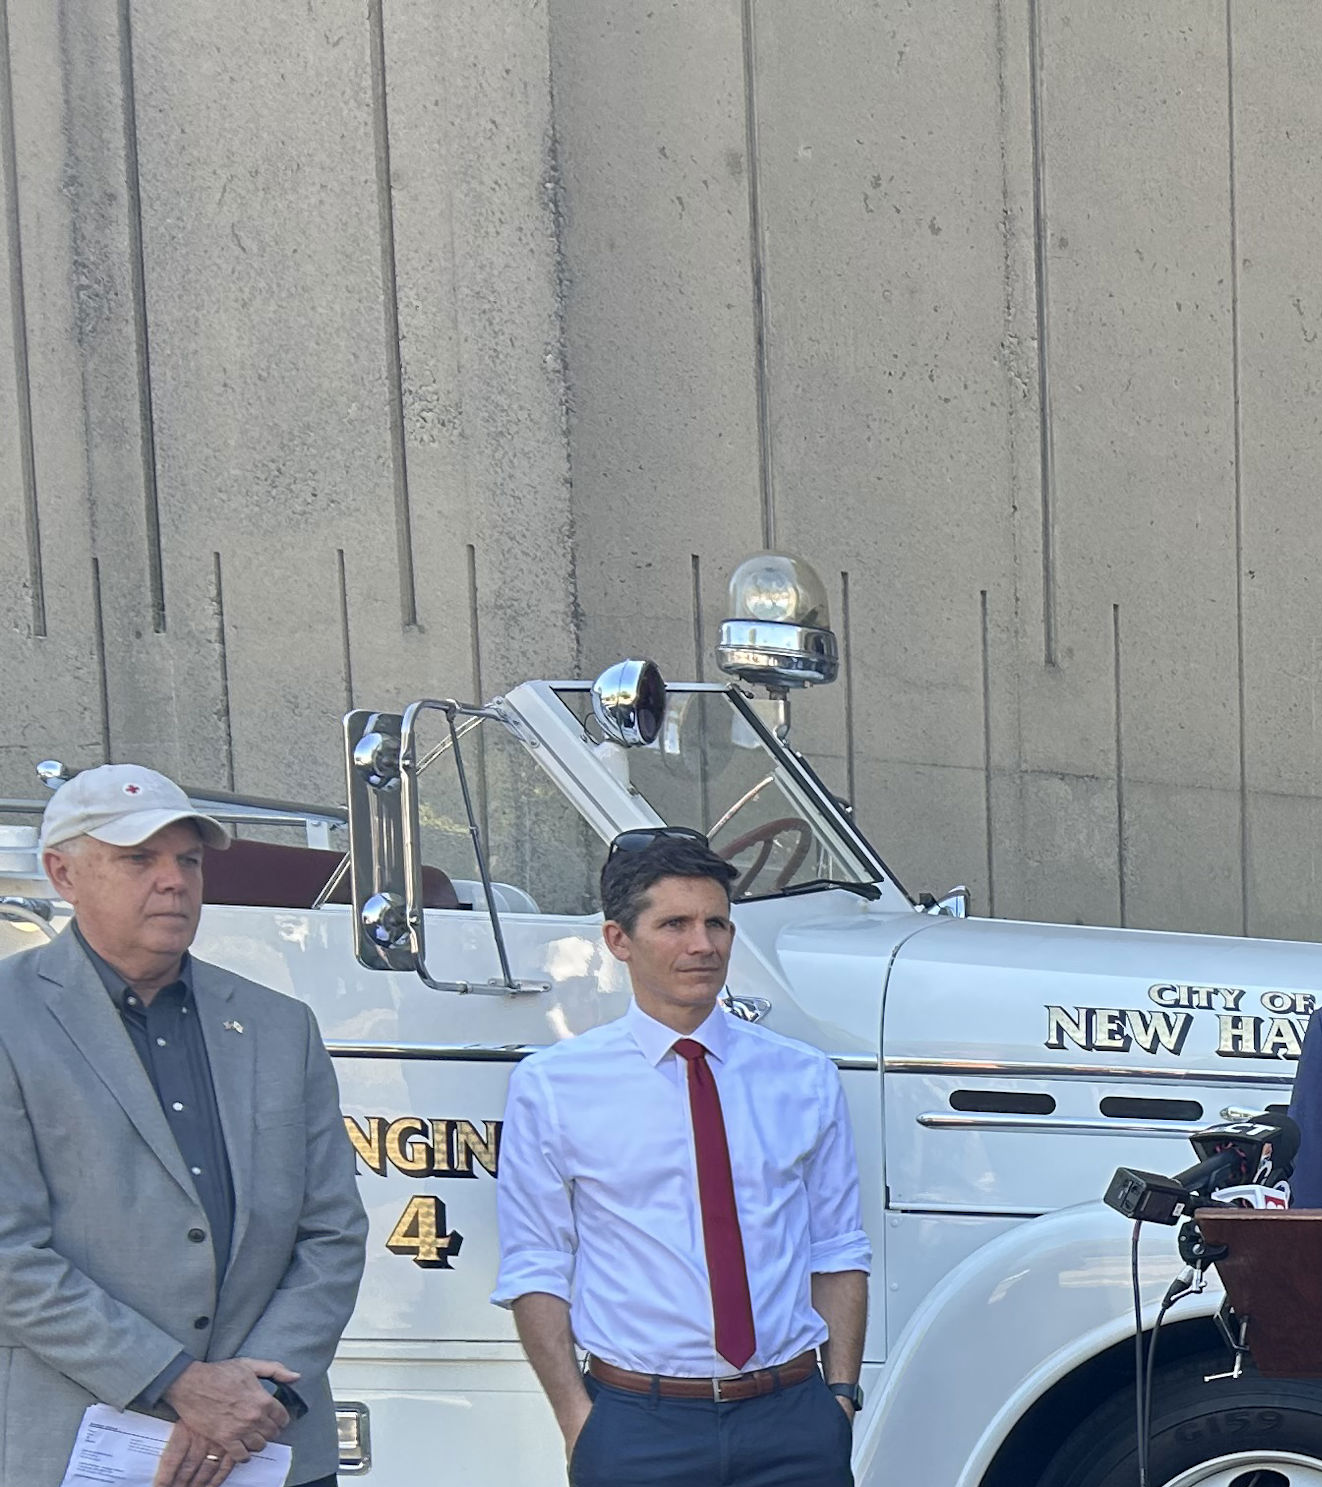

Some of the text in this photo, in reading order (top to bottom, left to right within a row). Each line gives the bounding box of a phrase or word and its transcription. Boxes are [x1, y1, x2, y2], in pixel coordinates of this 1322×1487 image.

[1148, 983, 1316, 1015] CITY OF
[1044, 1004, 1194, 1056] NEW
[385, 1194, 464, 1270] 4
